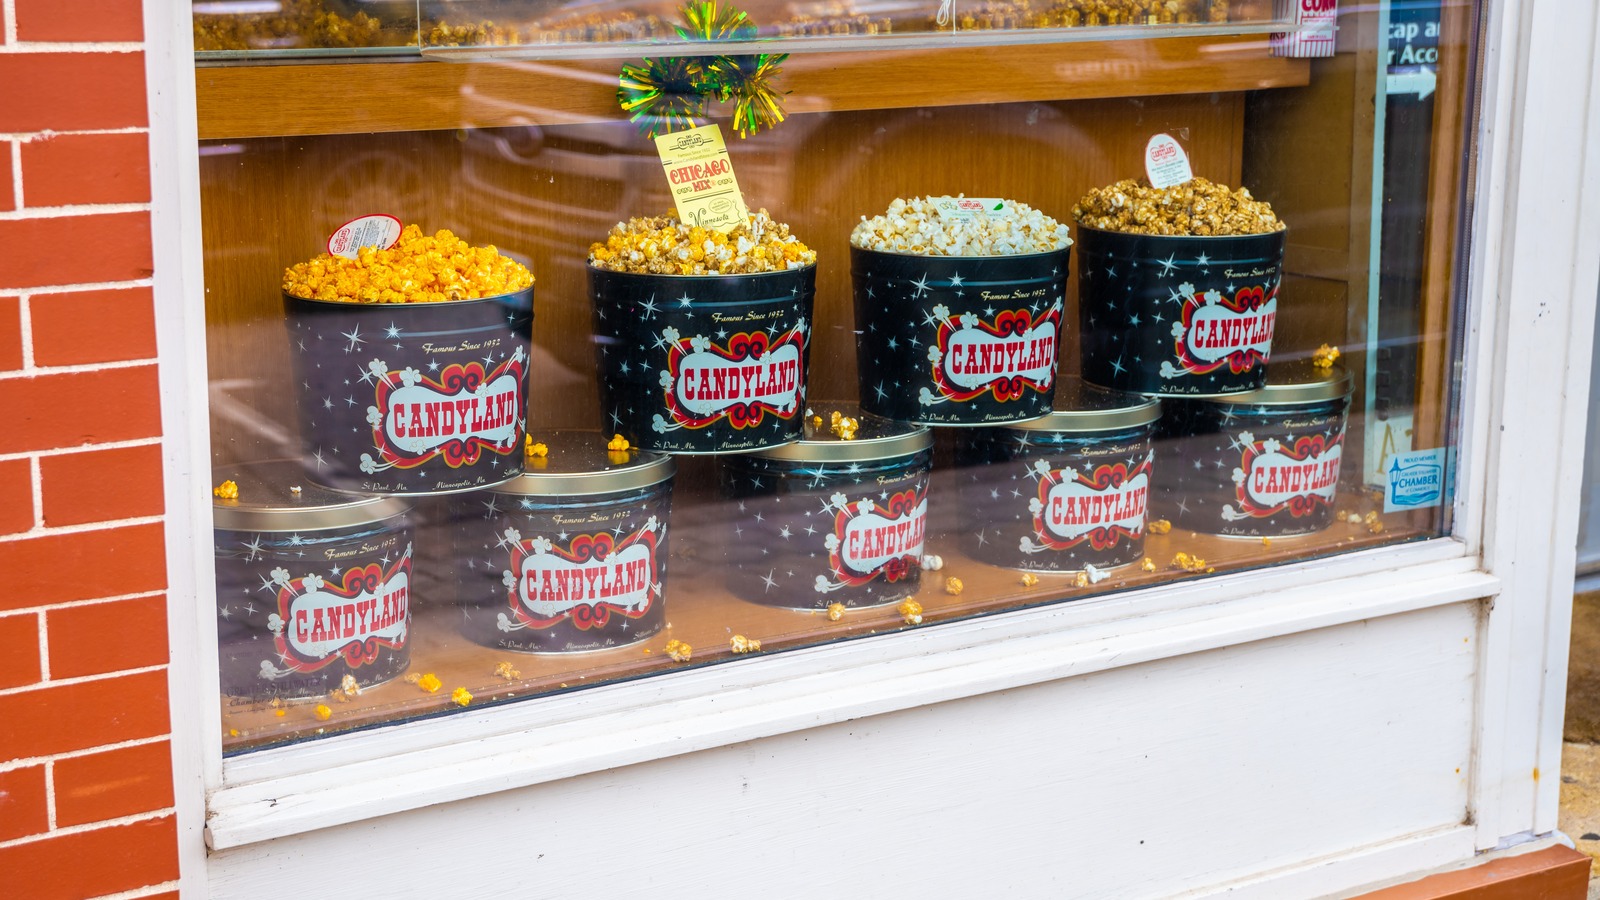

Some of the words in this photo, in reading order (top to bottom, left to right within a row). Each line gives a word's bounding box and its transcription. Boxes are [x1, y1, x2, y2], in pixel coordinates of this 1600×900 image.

[669, 158, 730, 185] CHICAGO
[981, 290, 1009, 302] Famous
[1011, 289, 1030, 299] Since
[1032, 288, 1046, 297] 1932
[711, 312, 743, 323] Famous
[745, 310, 766, 321] Since
[768, 309, 785, 318] 1932
[422, 342, 457, 355] Famous
[458, 339, 481, 352] Since
[483, 338, 501, 349] 1932
[952, 336, 1053, 375] CANDYLAND
[684, 359, 797, 401] CANDYLAND
[393, 390, 515, 438] CANDYLAND
[1398, 474, 1438, 489] CHAMBER
[552, 515, 586, 526] Famous
[587, 512, 610, 523] Since
[612, 510, 631, 520] 1932
[1052, 486, 1146, 525] CANDYLAND
[324, 548, 358, 561] Famous
[359, 543, 380, 555] Since
[381, 537, 397, 549] 1932
[525, 558, 648, 602] CANDYLAND
[295, 586, 406, 644] CANDYLAND
[229, 696, 265, 707] Chamber
